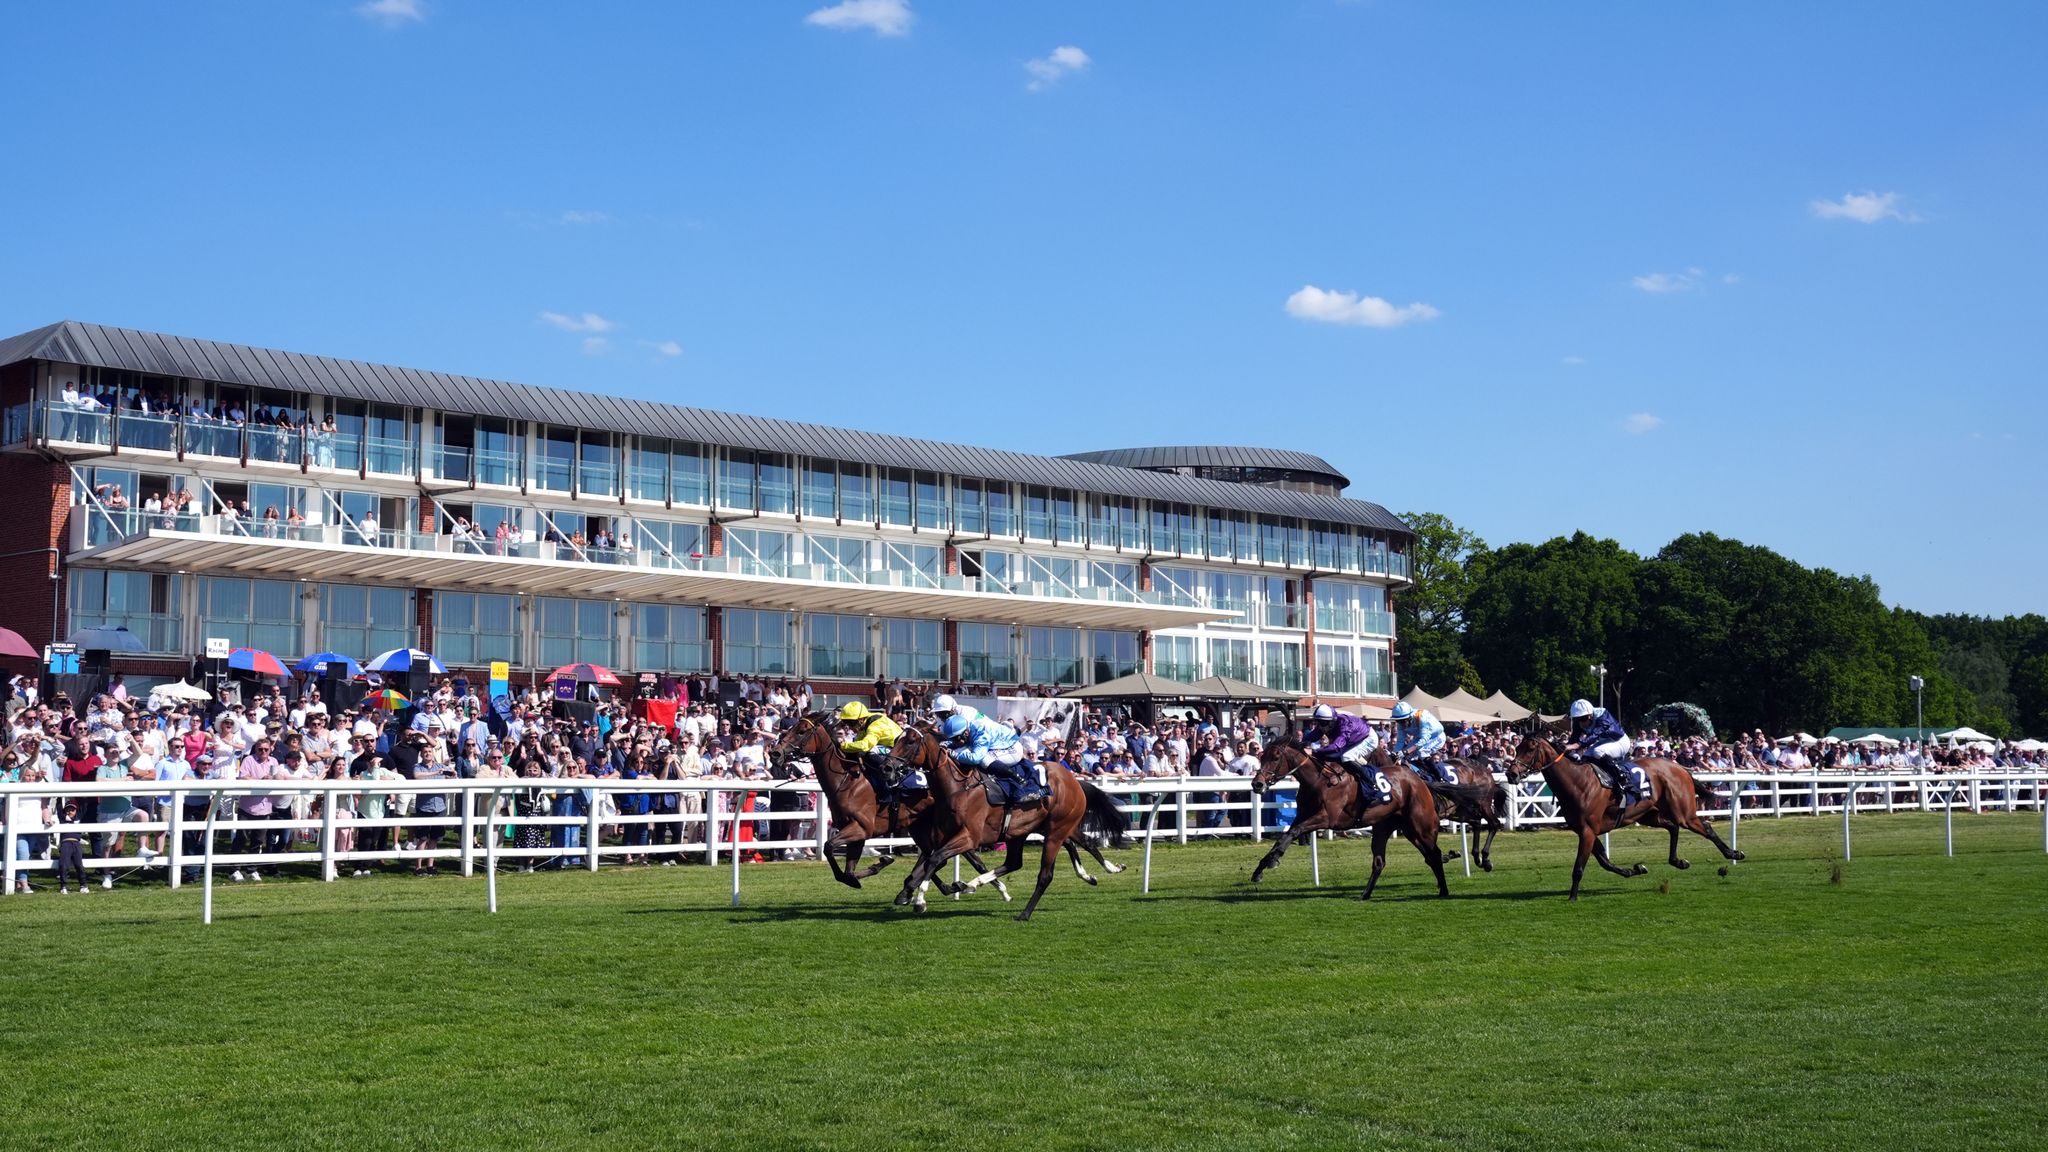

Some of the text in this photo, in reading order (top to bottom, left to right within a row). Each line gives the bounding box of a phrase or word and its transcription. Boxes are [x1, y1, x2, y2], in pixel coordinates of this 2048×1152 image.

[1033, 764, 1047, 787] 1
[1375, 772, 1392, 793] 6
[1444, 765, 1459, 786] 5
[1631, 767, 1650, 789] 2
